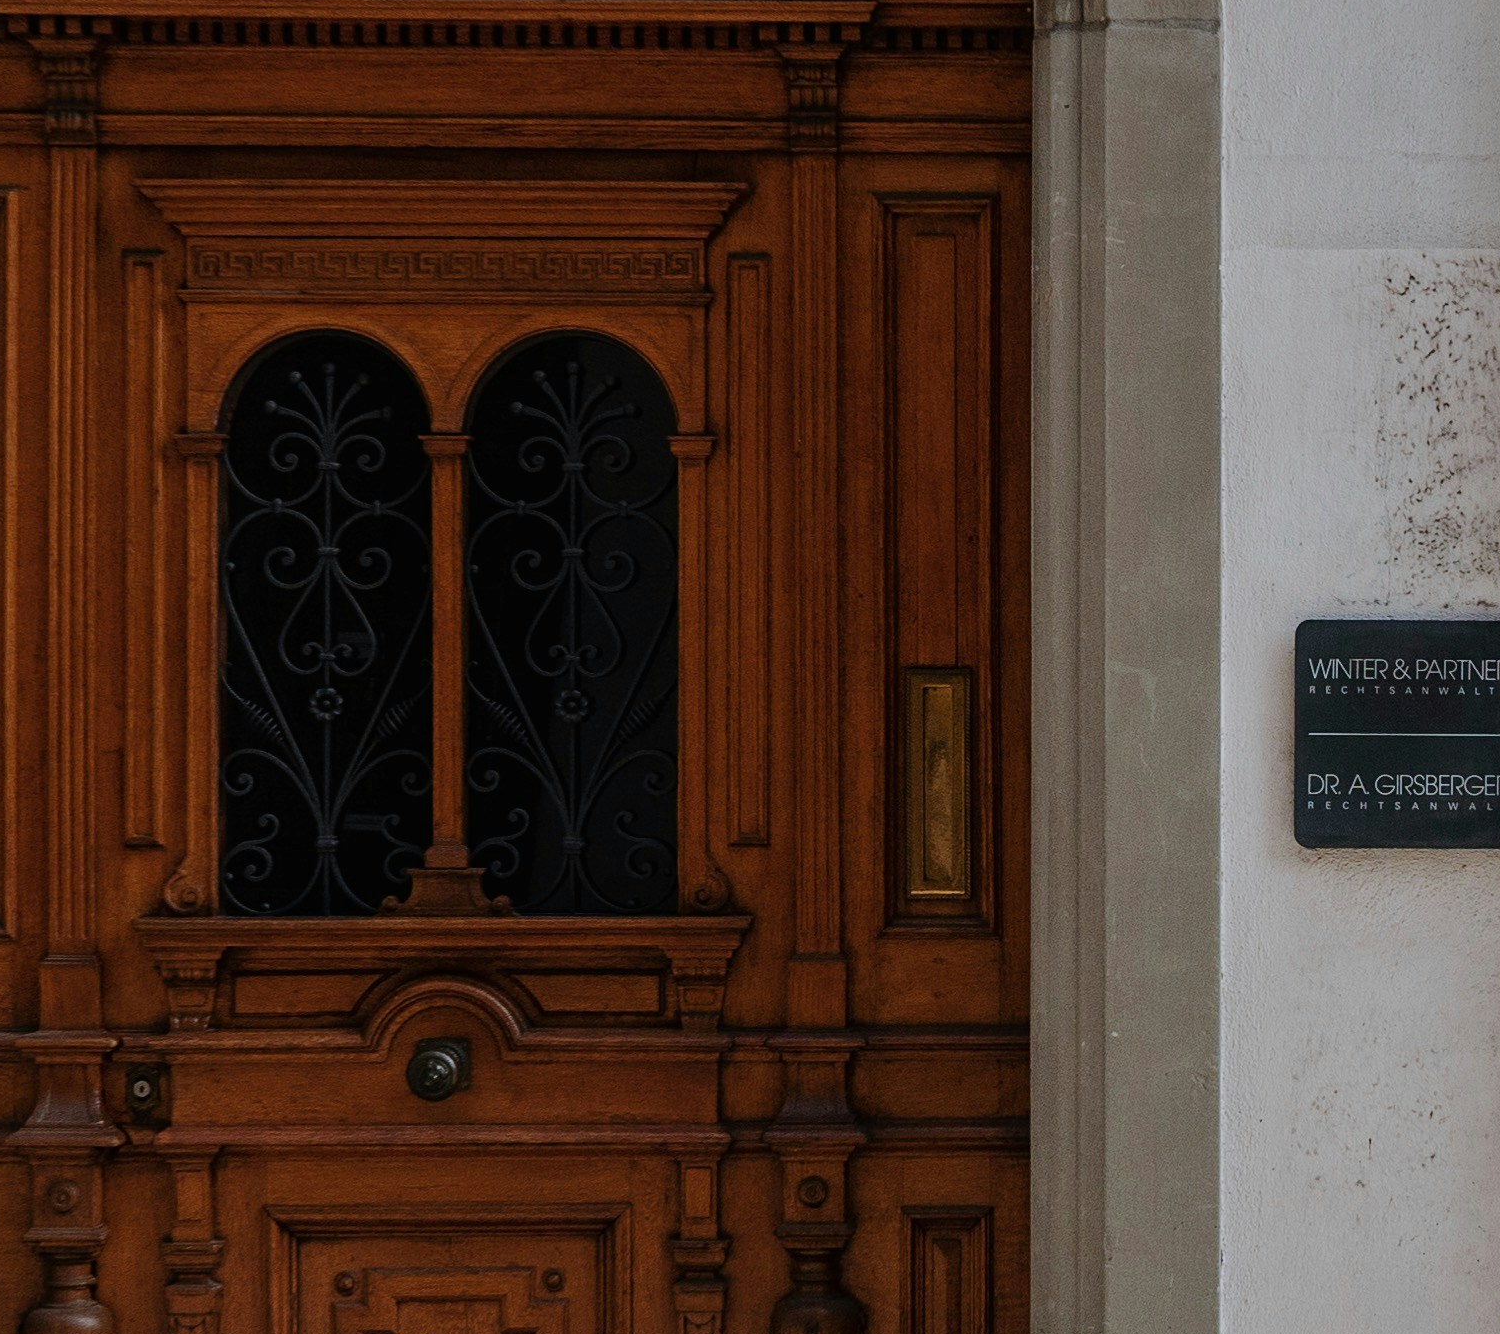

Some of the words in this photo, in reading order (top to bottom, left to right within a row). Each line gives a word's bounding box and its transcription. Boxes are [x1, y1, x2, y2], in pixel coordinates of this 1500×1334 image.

[1308, 658, 1389, 680] WINTER
[1392, 658, 1412, 680] &
[1307, 773, 1342, 795] DR.
[1348, 774, 1370, 795] A.
